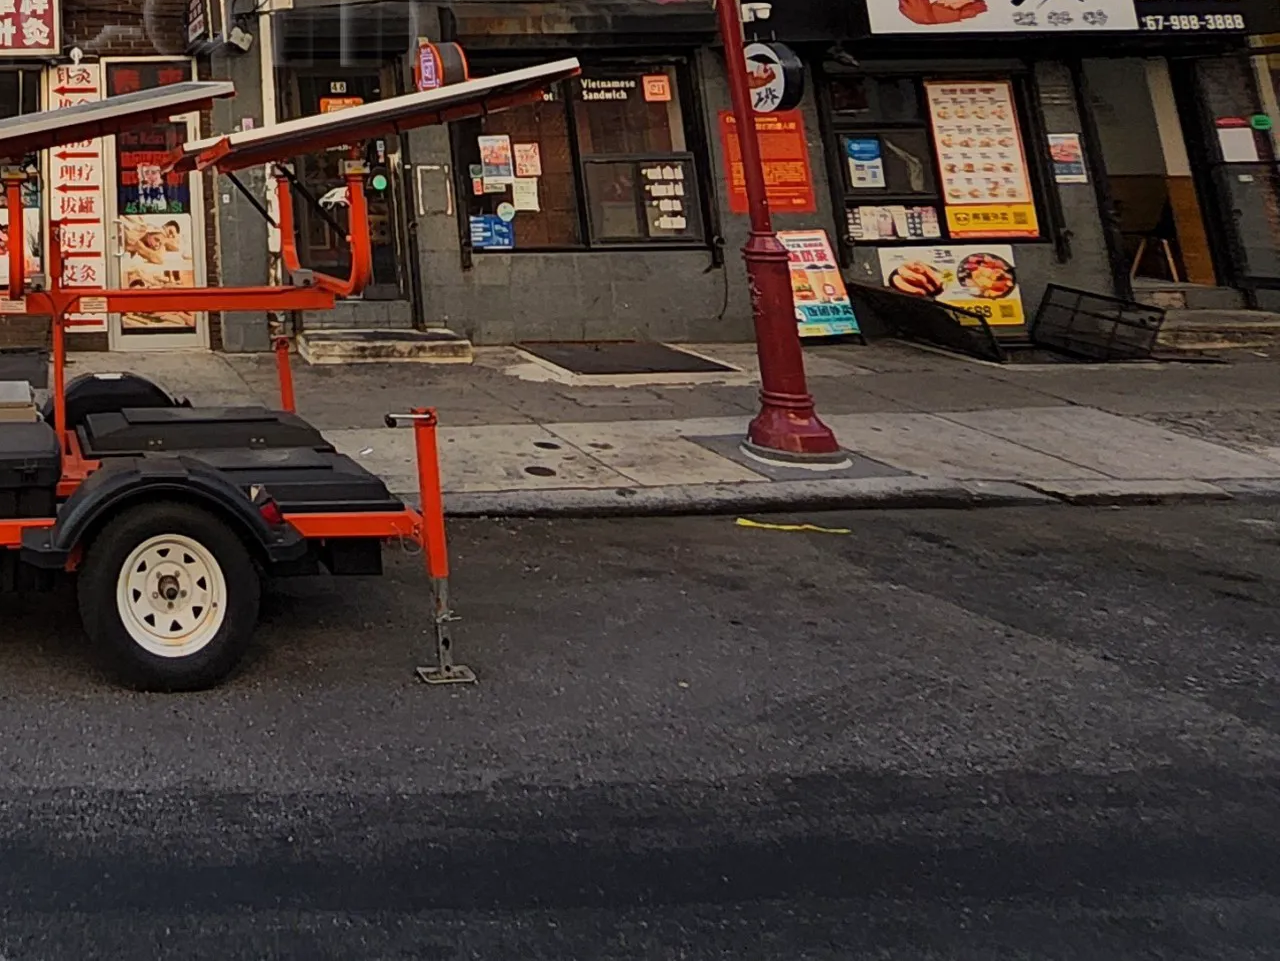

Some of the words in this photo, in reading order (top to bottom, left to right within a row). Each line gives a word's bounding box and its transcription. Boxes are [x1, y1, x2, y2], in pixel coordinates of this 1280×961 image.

[581, 78, 636, 89] Vietnamese
[582, 90, 628, 101] Sandwich
[59, 164, 94, 182] 理疗
